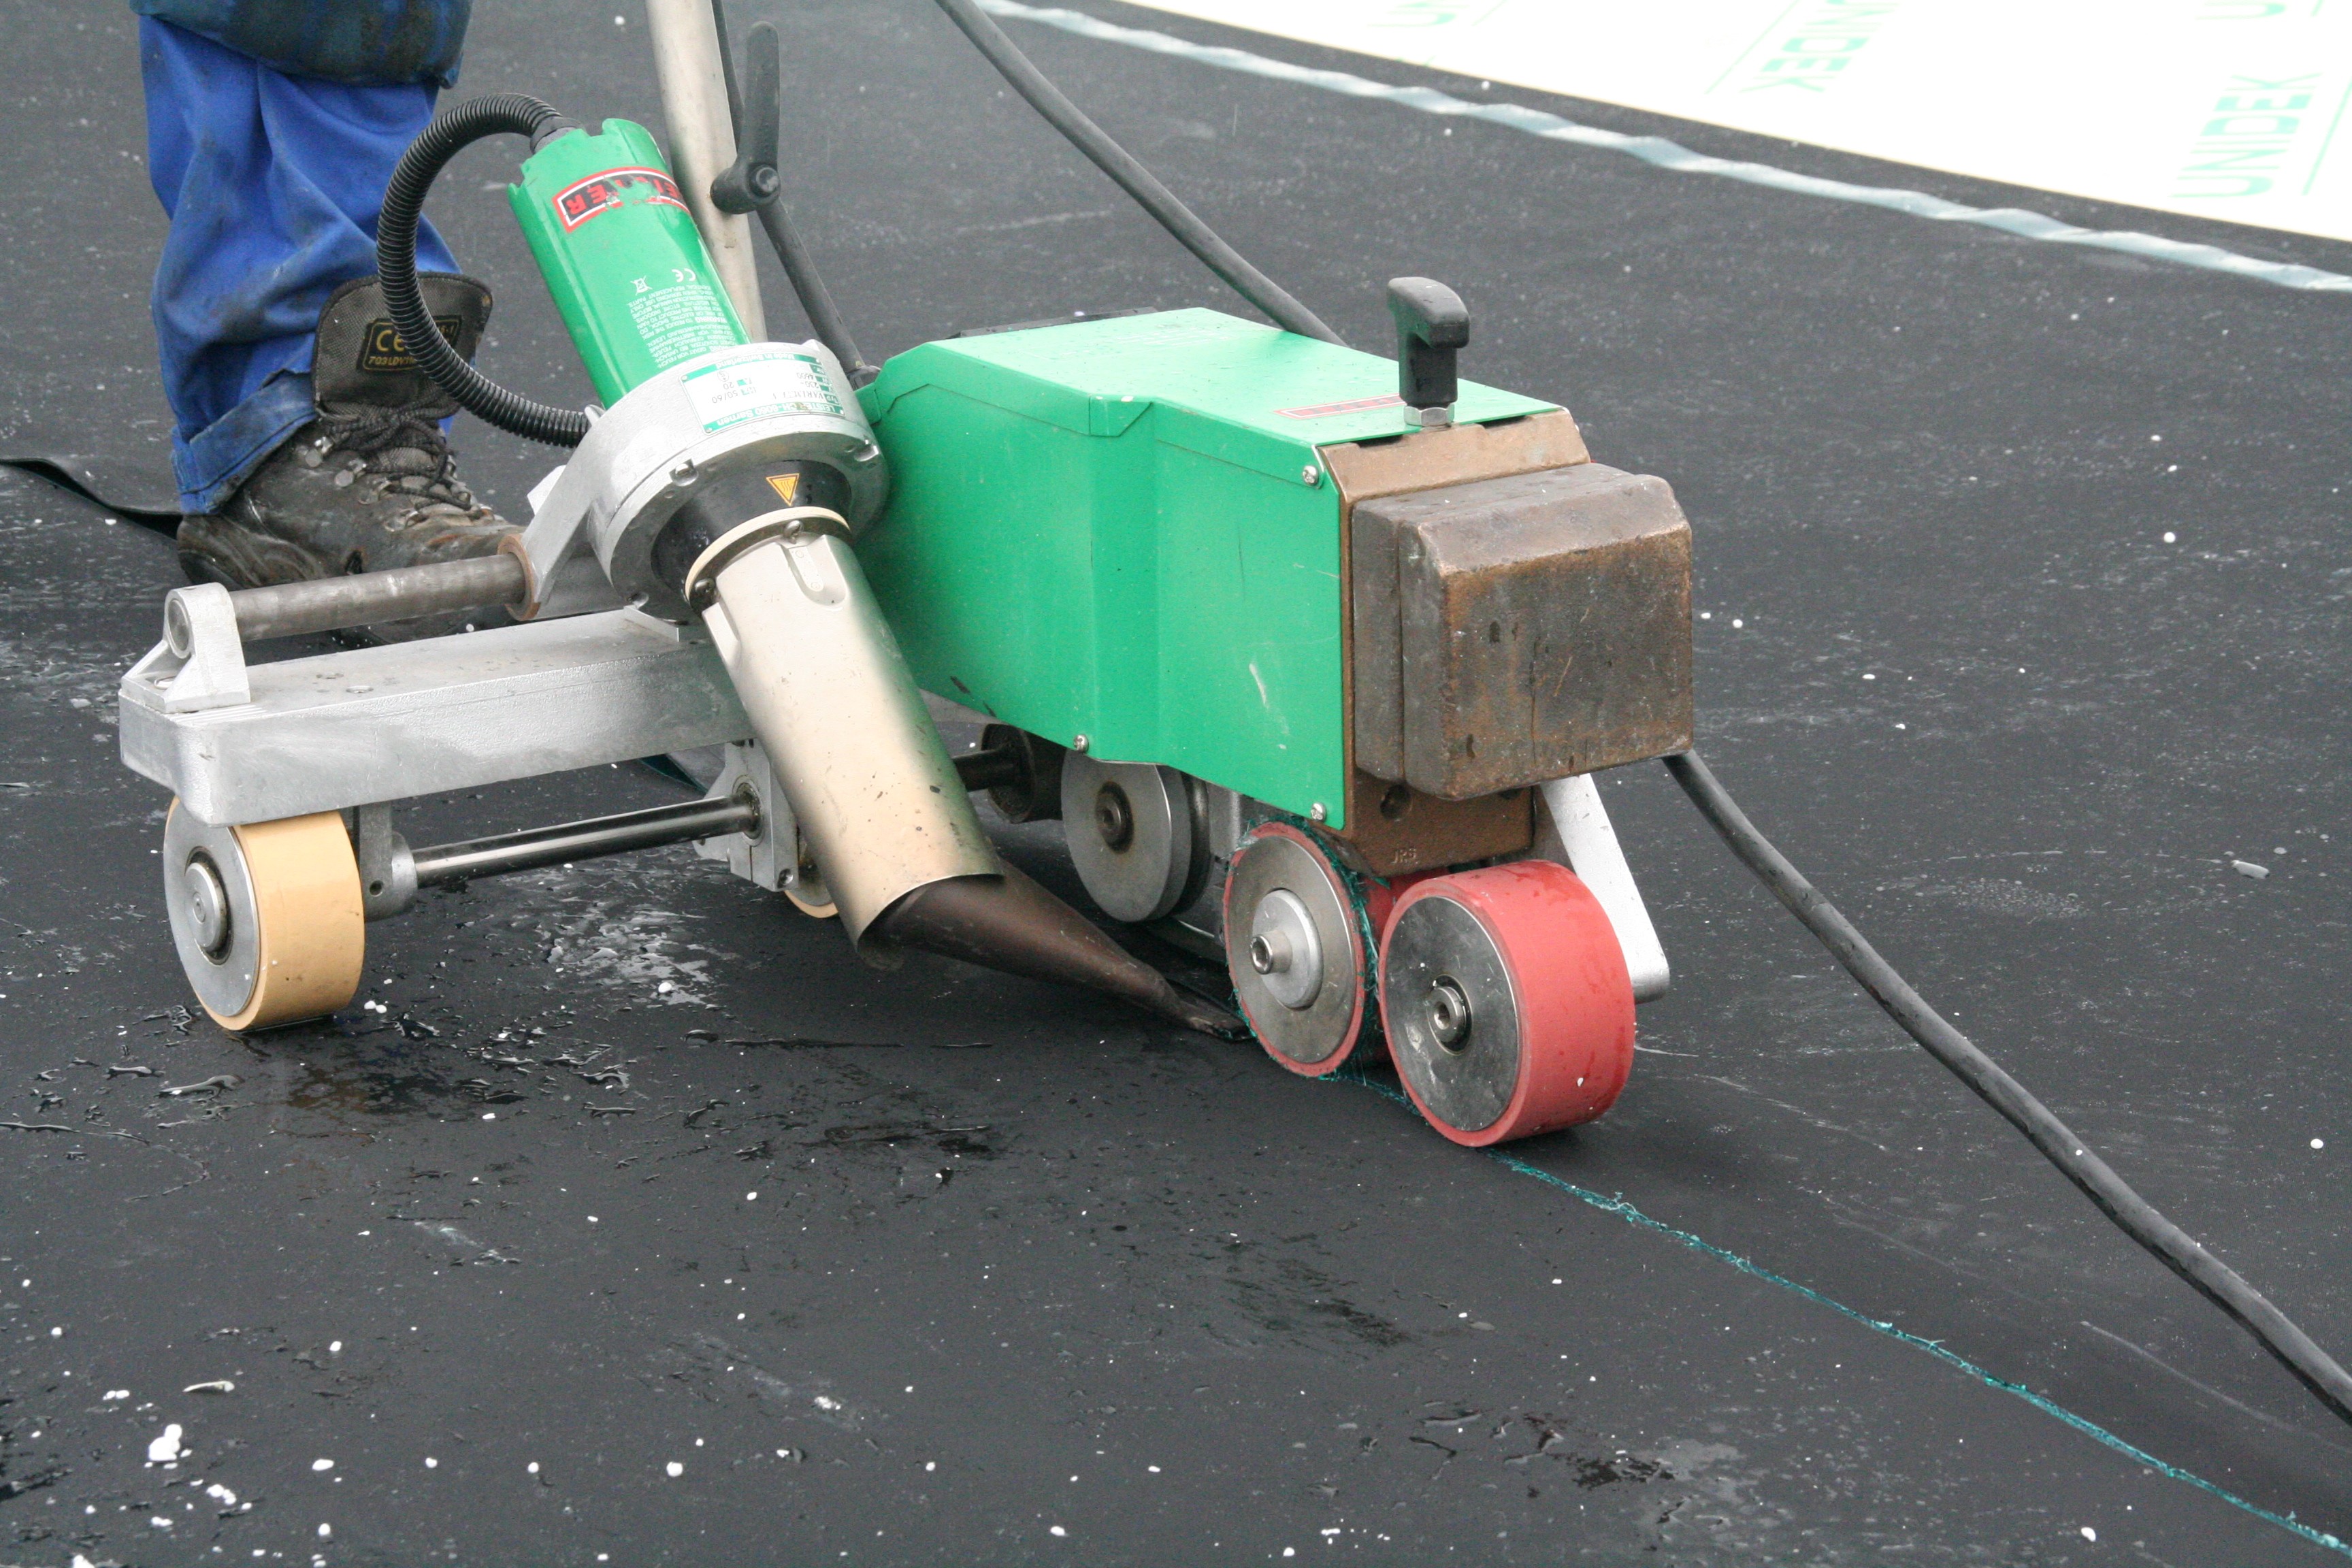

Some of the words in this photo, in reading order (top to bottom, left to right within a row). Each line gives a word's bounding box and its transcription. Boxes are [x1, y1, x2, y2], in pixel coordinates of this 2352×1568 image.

[2169, 72, 2323, 197] UNIDEK
[671, 268, 696, 283] CE
[723, 382, 735, 390] 20
[711, 390, 738, 404] 50/60
[798, 402, 836, 412] LEISTER
[717, 410, 753, 427] Sarnen
